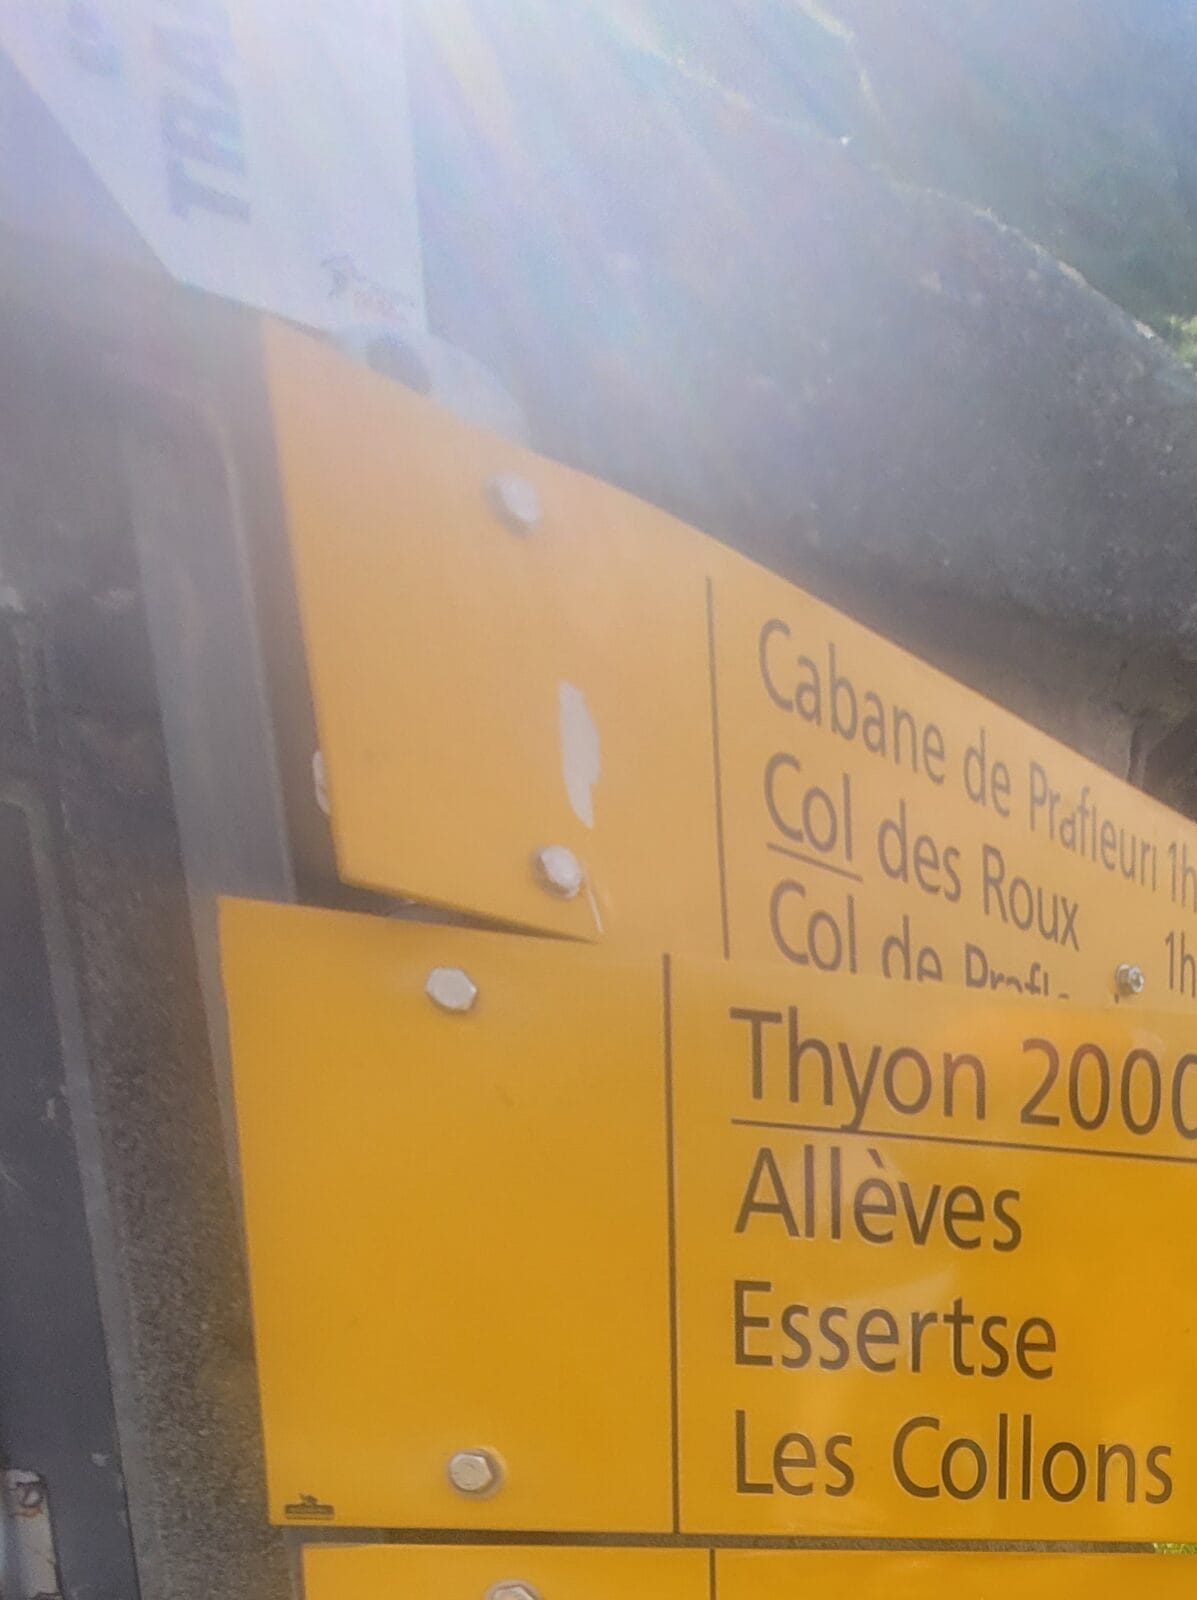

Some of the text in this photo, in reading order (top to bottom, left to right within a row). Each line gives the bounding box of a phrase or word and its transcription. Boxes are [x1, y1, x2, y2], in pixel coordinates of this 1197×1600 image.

[758, 618, 946, 784] Cabane
[963, 727, 1011, 818] de
[763, 752, 1080, 952] Col des Roux
[769, 879, 858, 976] Col
[729, 1005, 988, 1134] Thyon
[733, 1143, 1023, 1253] Allèves
[733, 1279, 1058, 1381] Essertse
[734, 1409, 857, 1499] Les
[892, 1412, 1174, 1505] Collons
